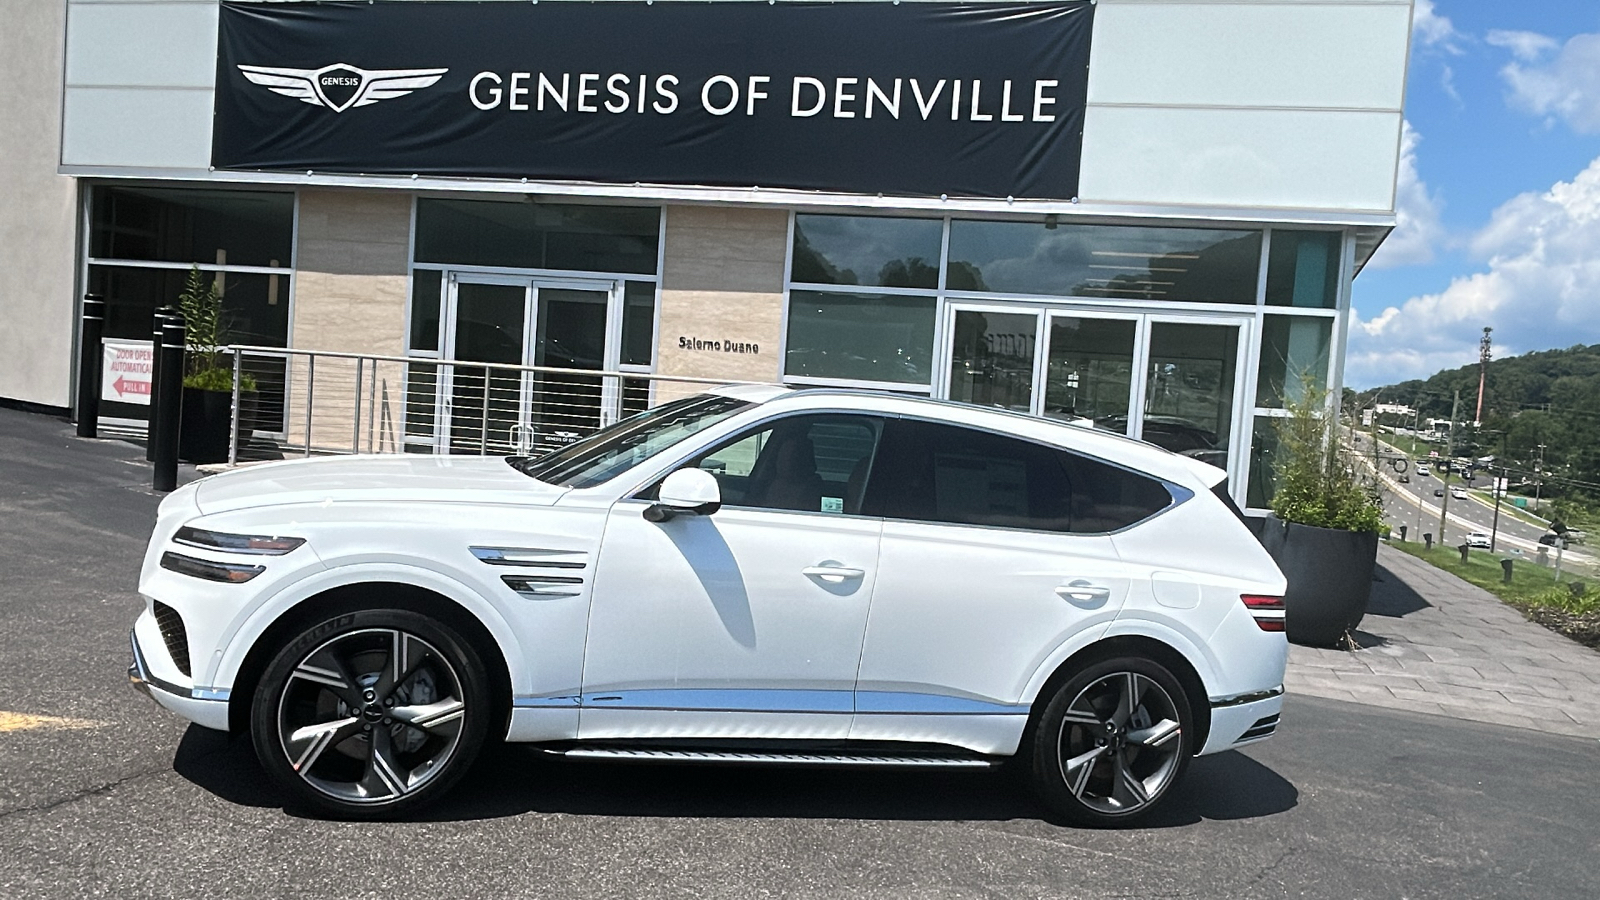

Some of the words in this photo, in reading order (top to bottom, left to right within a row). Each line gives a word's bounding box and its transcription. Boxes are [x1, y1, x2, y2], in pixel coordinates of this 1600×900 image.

[321, 77, 359, 86] GENESIS
[469, 71, 679, 114] GENESIS
[701, 74, 771, 116] OF
[791, 76, 1059, 122] DENVILLE
[723, 339, 759, 354] Duane
[116, 349, 134, 360] DOOR
[123, 382, 138, 392] PULL
[139, 383, 146, 392] IN
